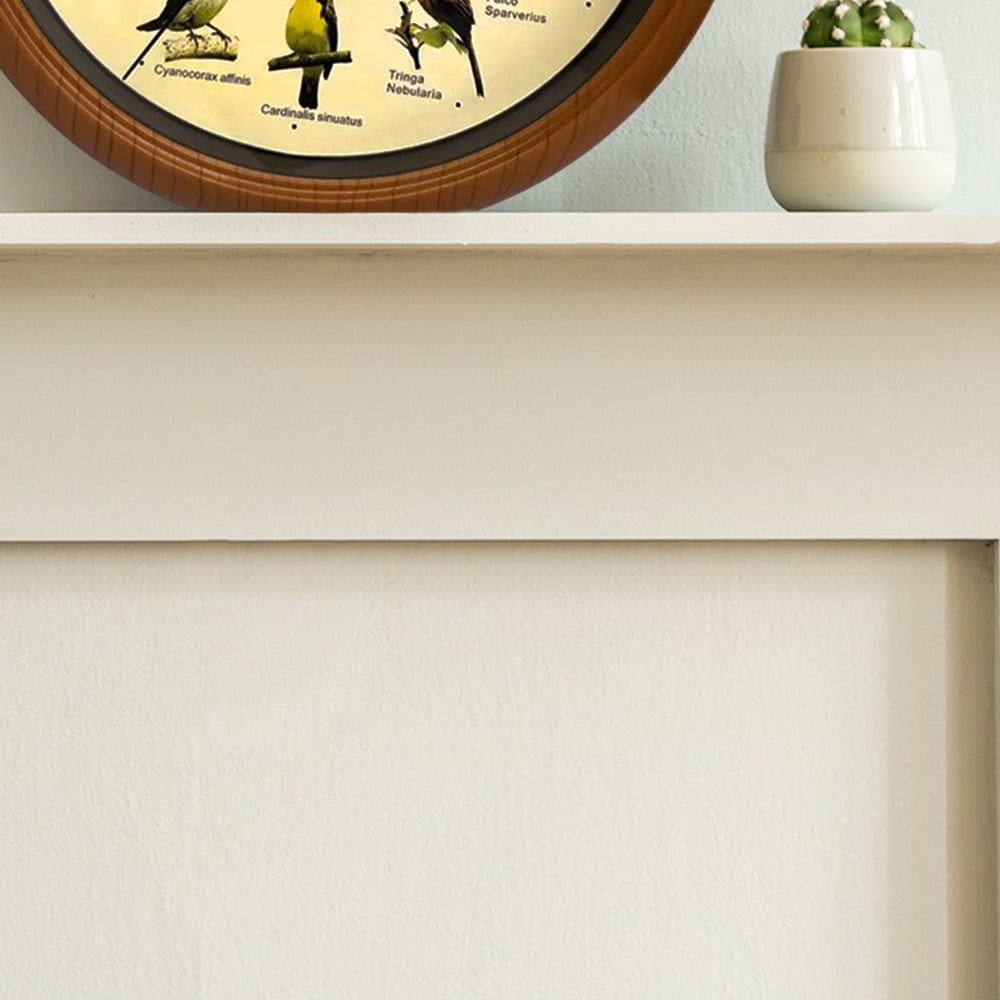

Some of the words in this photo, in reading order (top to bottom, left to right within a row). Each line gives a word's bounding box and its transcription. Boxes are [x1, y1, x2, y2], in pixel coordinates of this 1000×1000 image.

[484, 5, 547, 24] Sparverius
[154, 63, 218, 82] Cyanocorax
[219, 71, 252, 87] affinis
[388, 69, 425, 85] Tringa
[386, 83, 442, 100] Nebularia
[261, 103, 315, 121] Cardinalis
[316, 111, 363, 127] sinuatus
